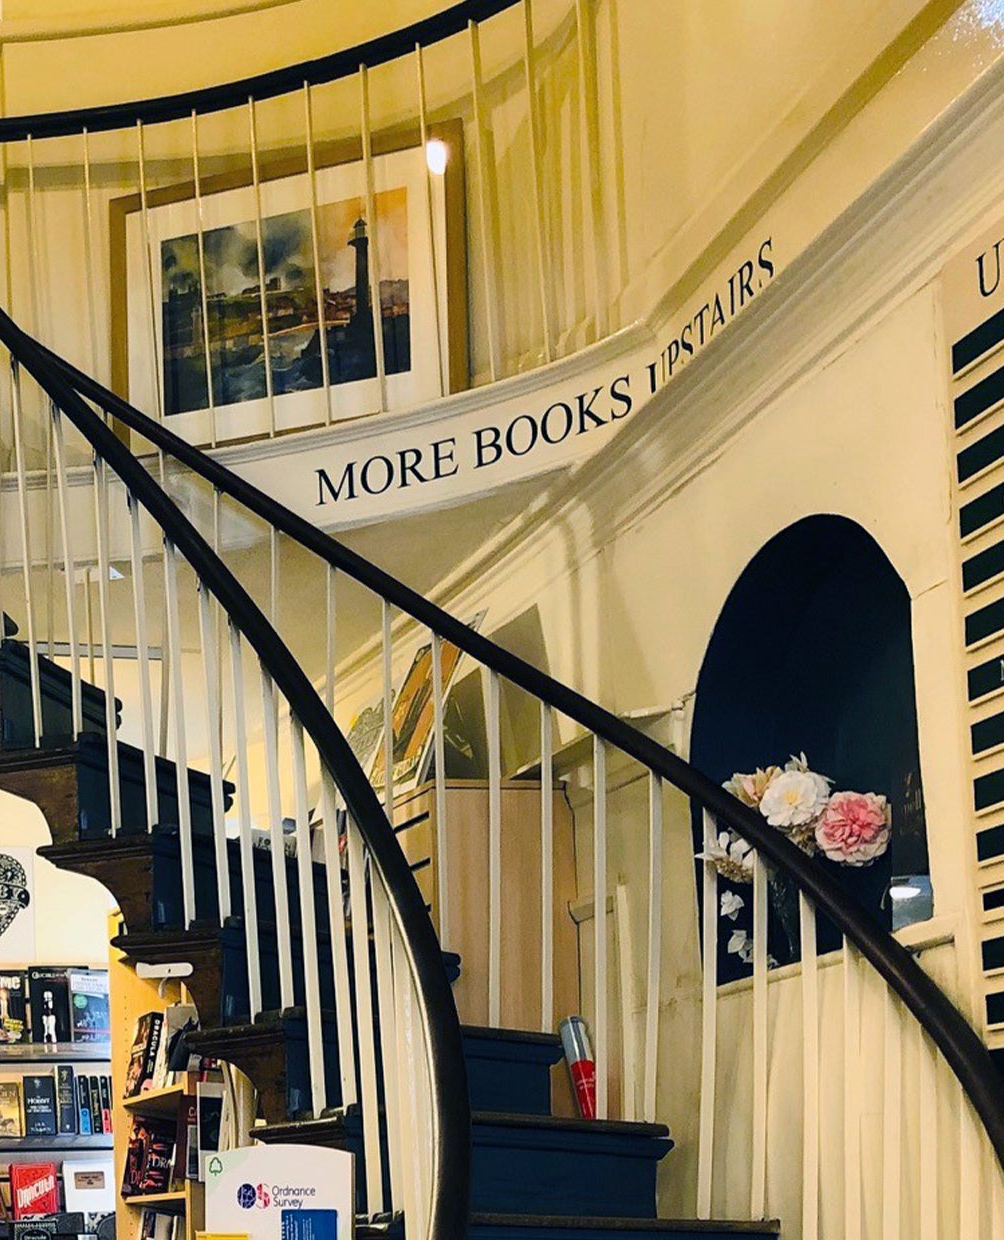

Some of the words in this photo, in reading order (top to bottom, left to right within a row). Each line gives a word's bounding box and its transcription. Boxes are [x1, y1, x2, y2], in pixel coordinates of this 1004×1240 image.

[314, 437, 458, 507] MORE
[473, 376, 633, 469] BOOKS
[17, 1175, 55, 1208] DRACULA
[272, 1185, 316, 1196] Ordnance
[273, 1198, 303, 1209] Survey
